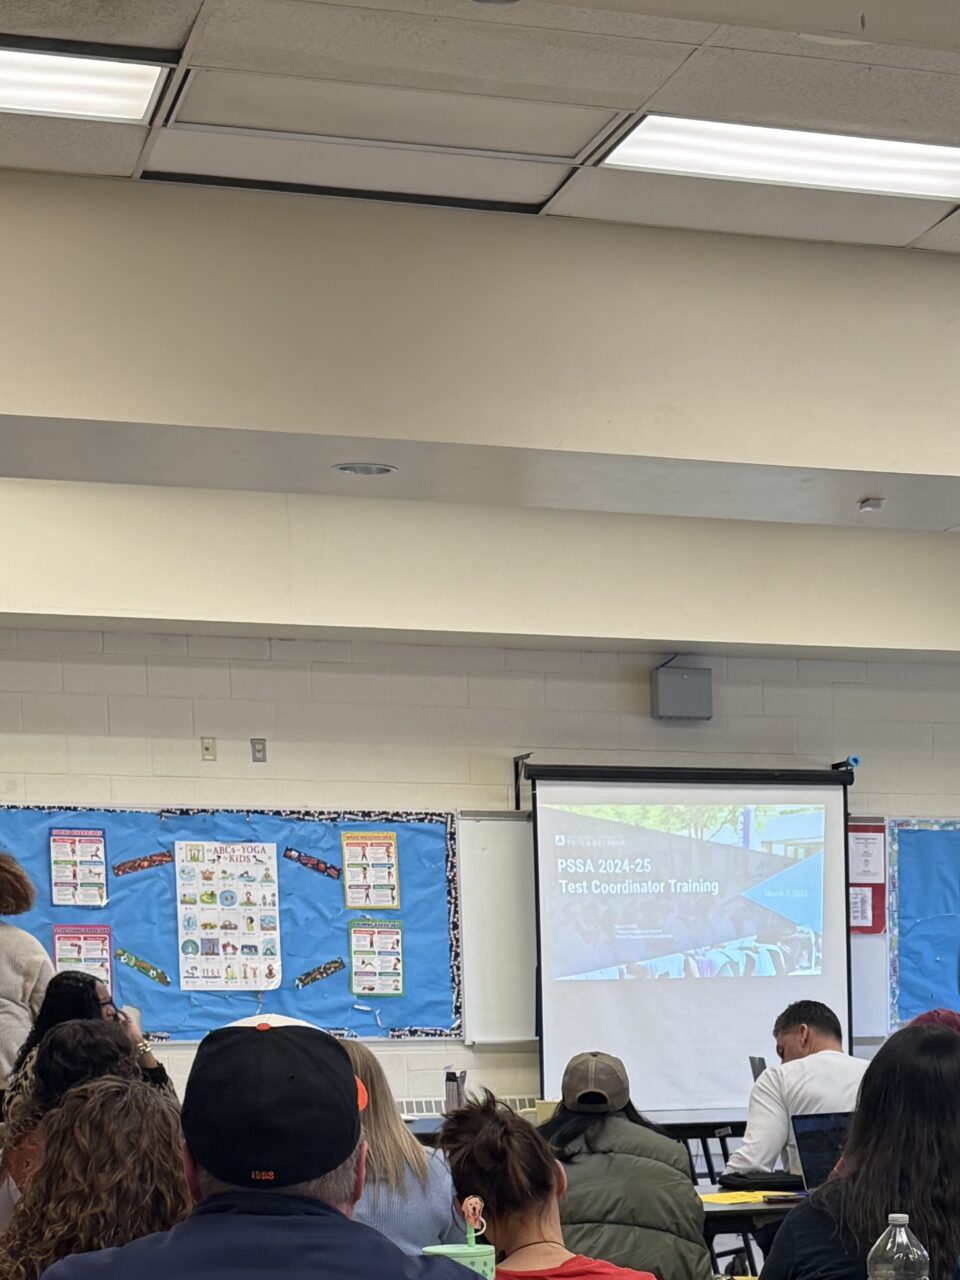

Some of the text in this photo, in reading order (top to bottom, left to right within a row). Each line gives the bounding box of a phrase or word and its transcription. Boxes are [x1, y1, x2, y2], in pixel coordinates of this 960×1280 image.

[241, 845, 267, 854] YOGA
[557, 858, 651, 873] PSSA 2024-25
[558, 878, 719, 896] Test Coordinator Training
